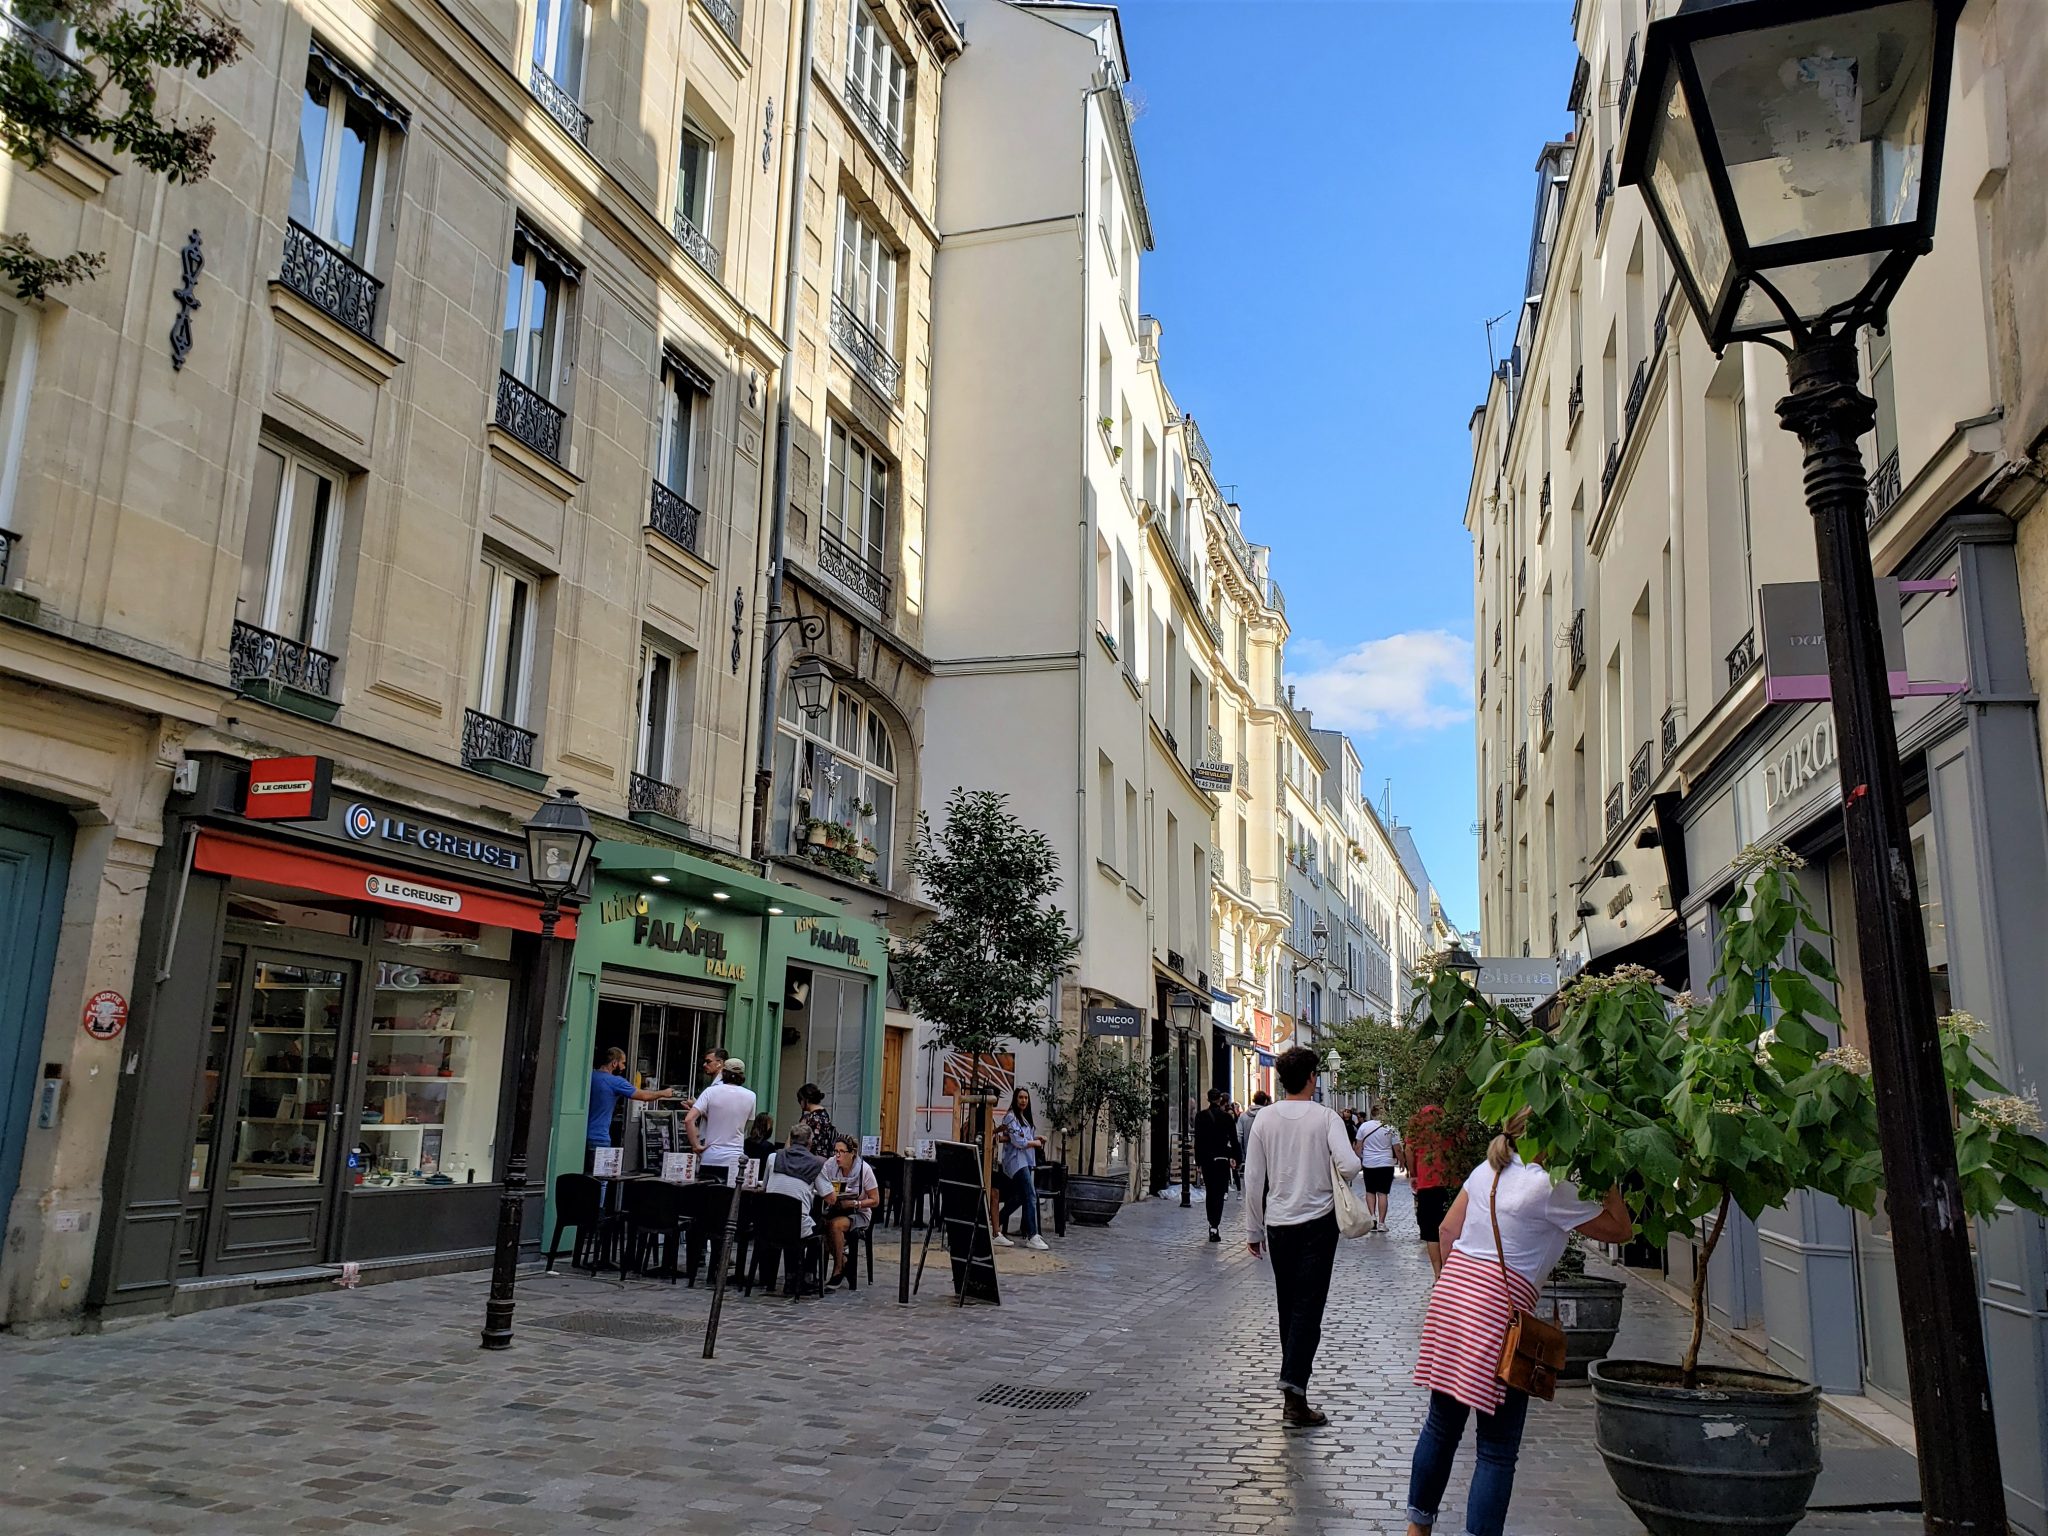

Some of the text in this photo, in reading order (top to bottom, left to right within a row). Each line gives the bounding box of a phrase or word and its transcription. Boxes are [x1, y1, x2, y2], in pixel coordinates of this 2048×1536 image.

[1206, 763, 1229, 771] LOUER
[382, 818, 524, 870] LE CREUSET
[385, 883, 454, 905] LE CREUSET
[634, 914, 727, 960] FALAFEL
[811, 927, 860, 957] FALAFEL
[705, 958, 746, 981] PALACE
[95, 992, 122, 1005] SORTIE
[1096, 1015, 1134, 1025] SUNCOO
